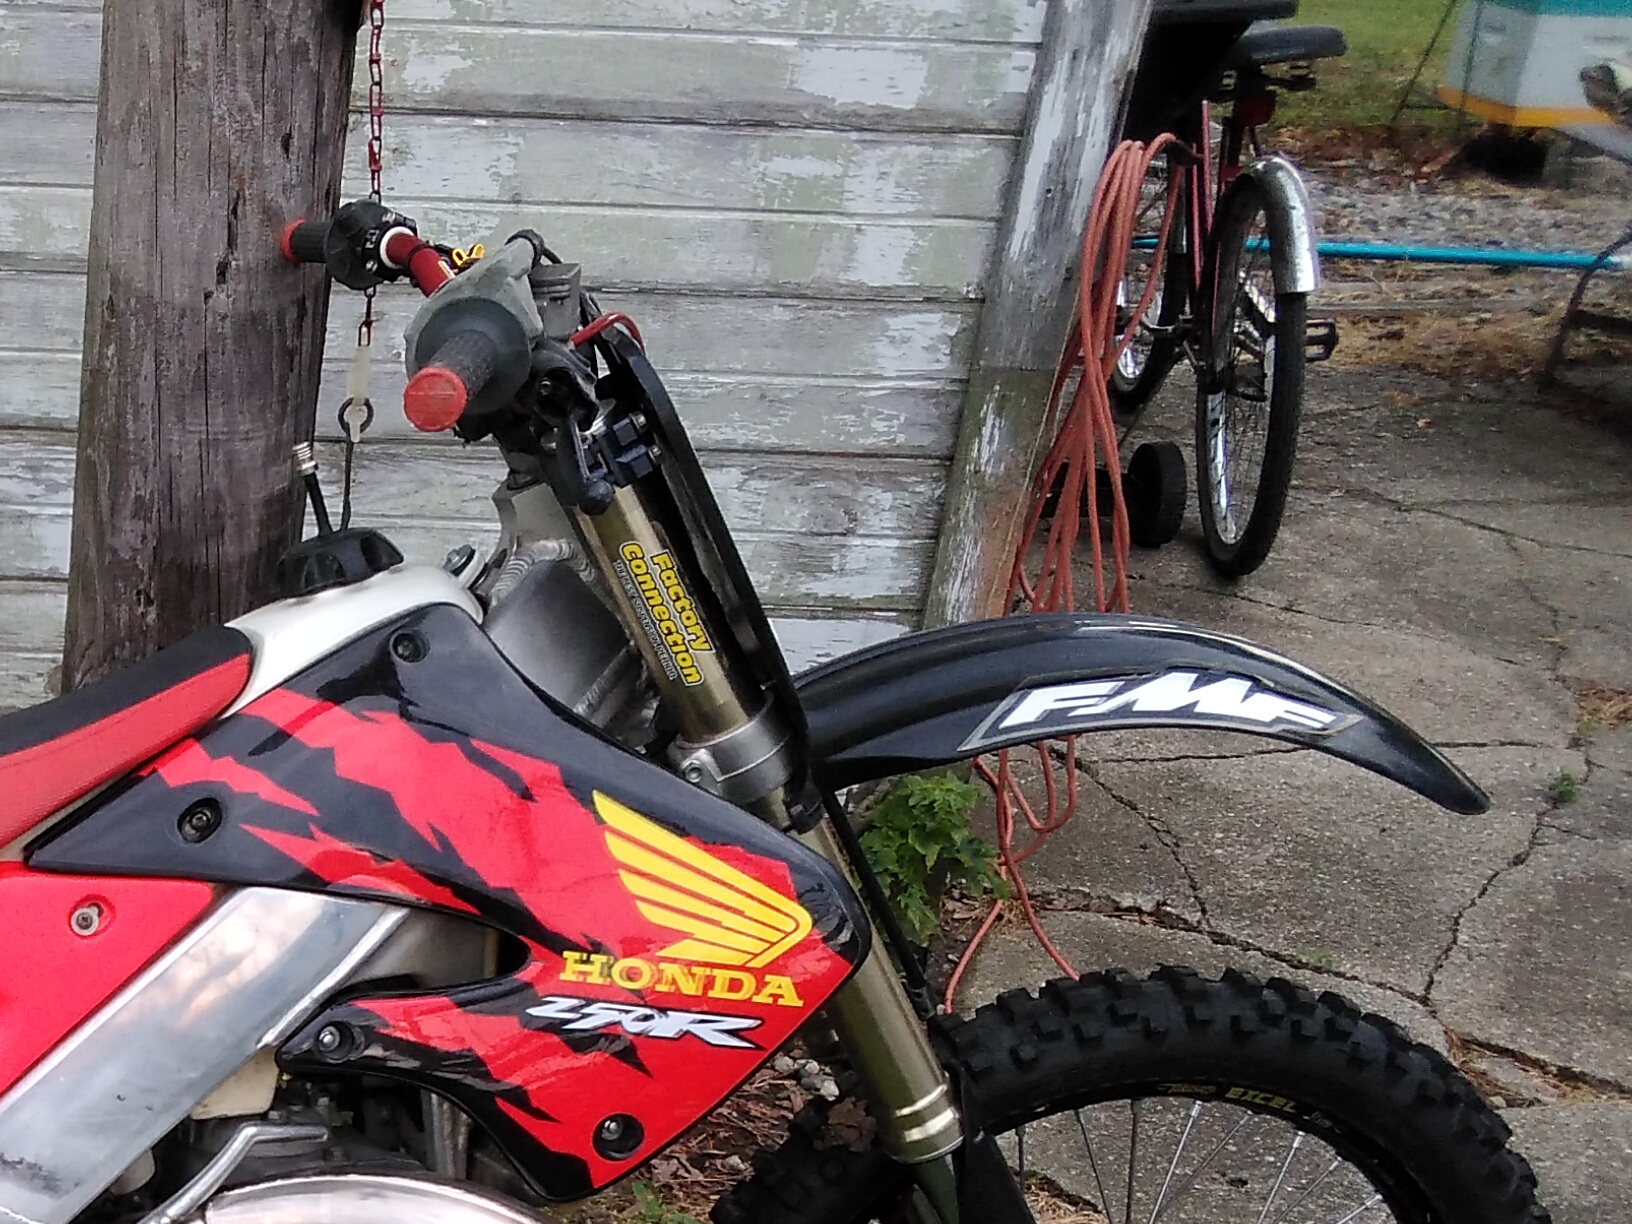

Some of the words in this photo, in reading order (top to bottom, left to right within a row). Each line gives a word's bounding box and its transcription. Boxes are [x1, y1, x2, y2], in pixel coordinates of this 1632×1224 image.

[621, 542, 703, 684] Connection
[649, 551, 713, 652] Factory
[998, 672, 1337, 729] FMF
[560, 950, 804, 1007] HONDA
[525, 995, 763, 1049] 250R
[1224, 1086, 1297, 1113] EXCEL
